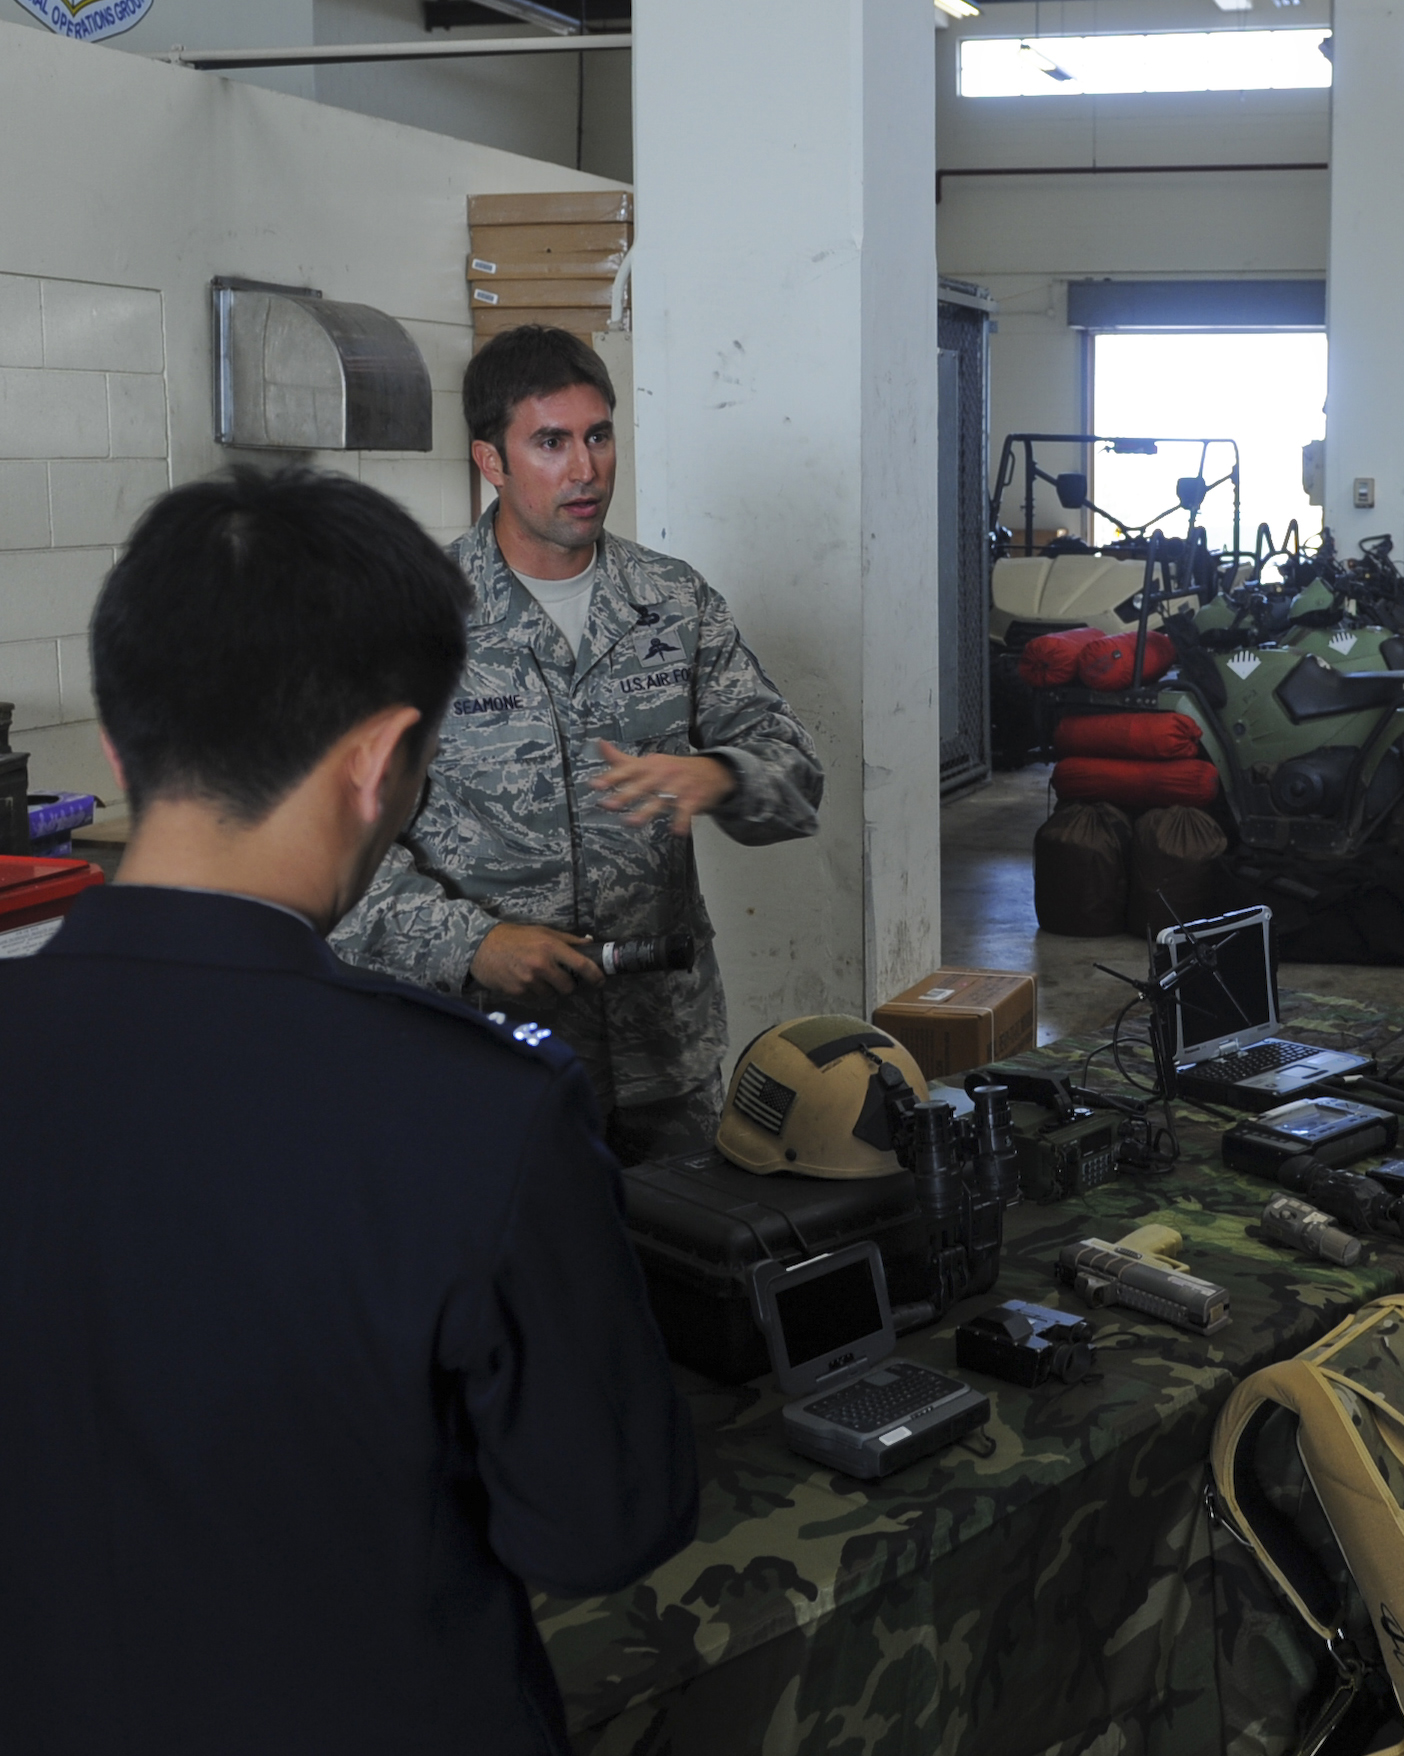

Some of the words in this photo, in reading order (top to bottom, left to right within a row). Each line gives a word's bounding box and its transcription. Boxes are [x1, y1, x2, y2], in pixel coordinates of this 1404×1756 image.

[51, 6, 115, 39] OPERATIONS
[114, 0, 145, 21] GROU
[646, 674, 670, 690] AIR
[674, 667, 692, 683] FO
[453, 695, 524, 716] SEAMONE
